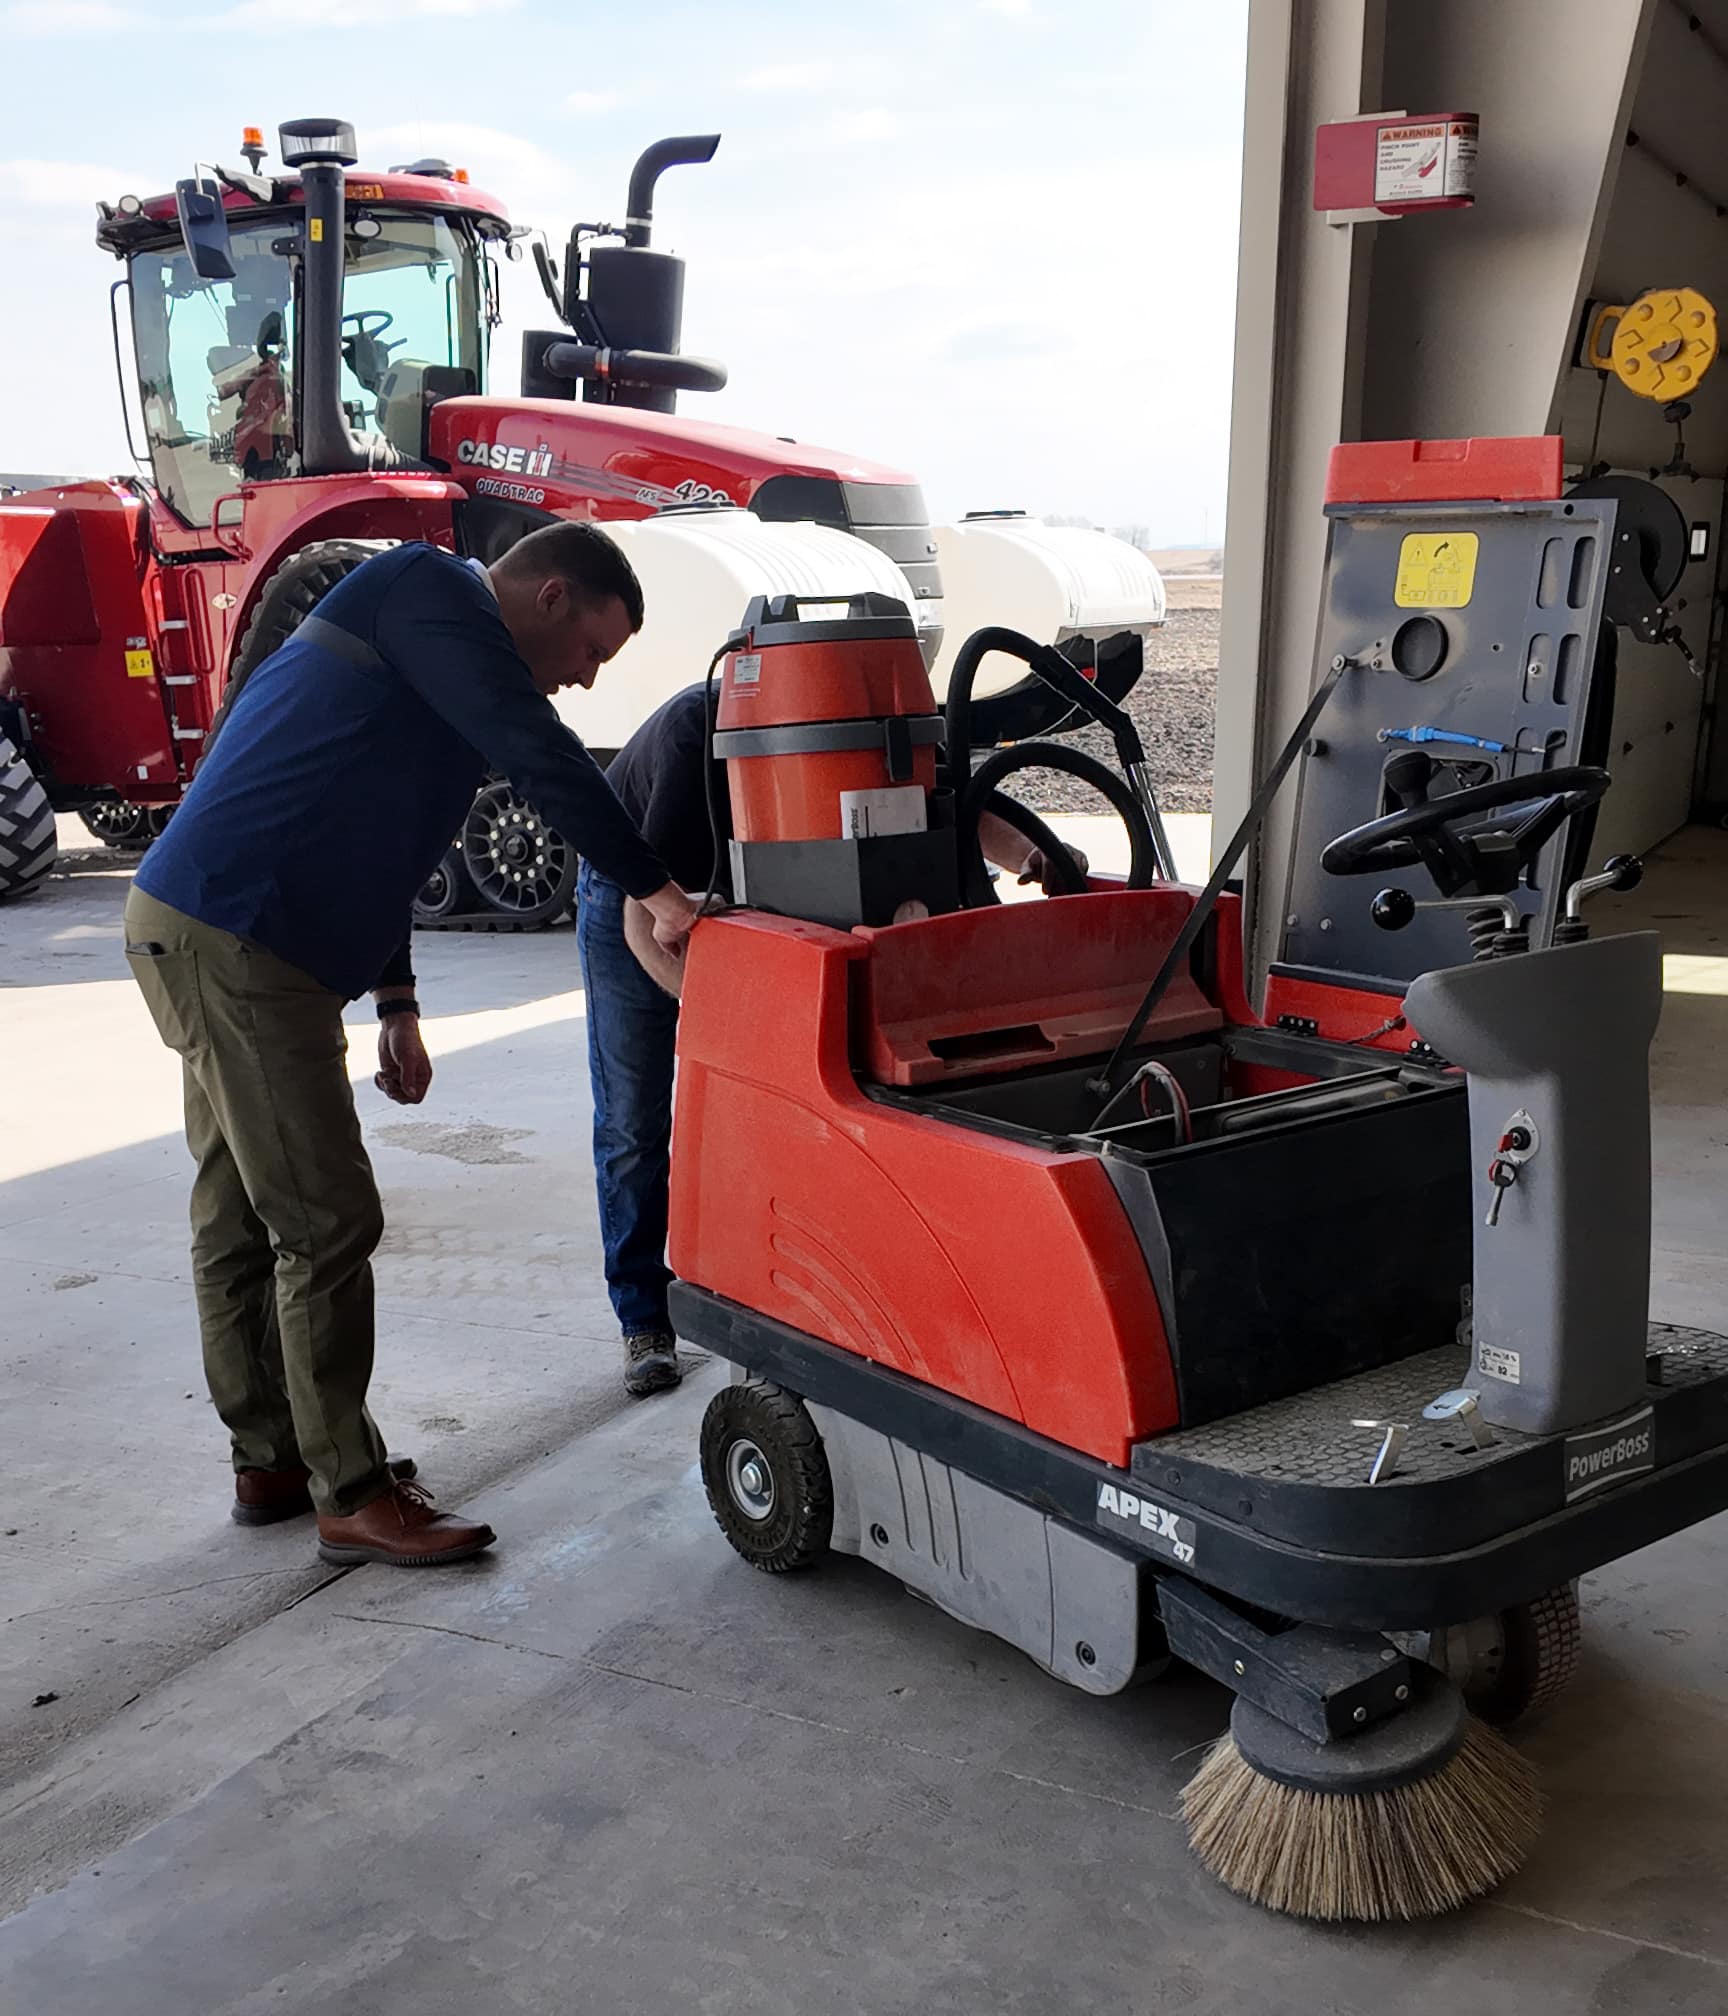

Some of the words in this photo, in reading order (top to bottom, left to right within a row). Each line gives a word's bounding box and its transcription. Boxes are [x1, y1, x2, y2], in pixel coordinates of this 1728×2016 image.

[1393, 128, 1441, 139] WARNING
[457, 439, 526, 473] CASE
[476, 478, 545, 504] QUADTRAC
[1568, 1431, 1650, 1481] PowerBoss
[1097, 1482, 1180, 1542] APEX
[1173, 1540, 1195, 1563] 47
